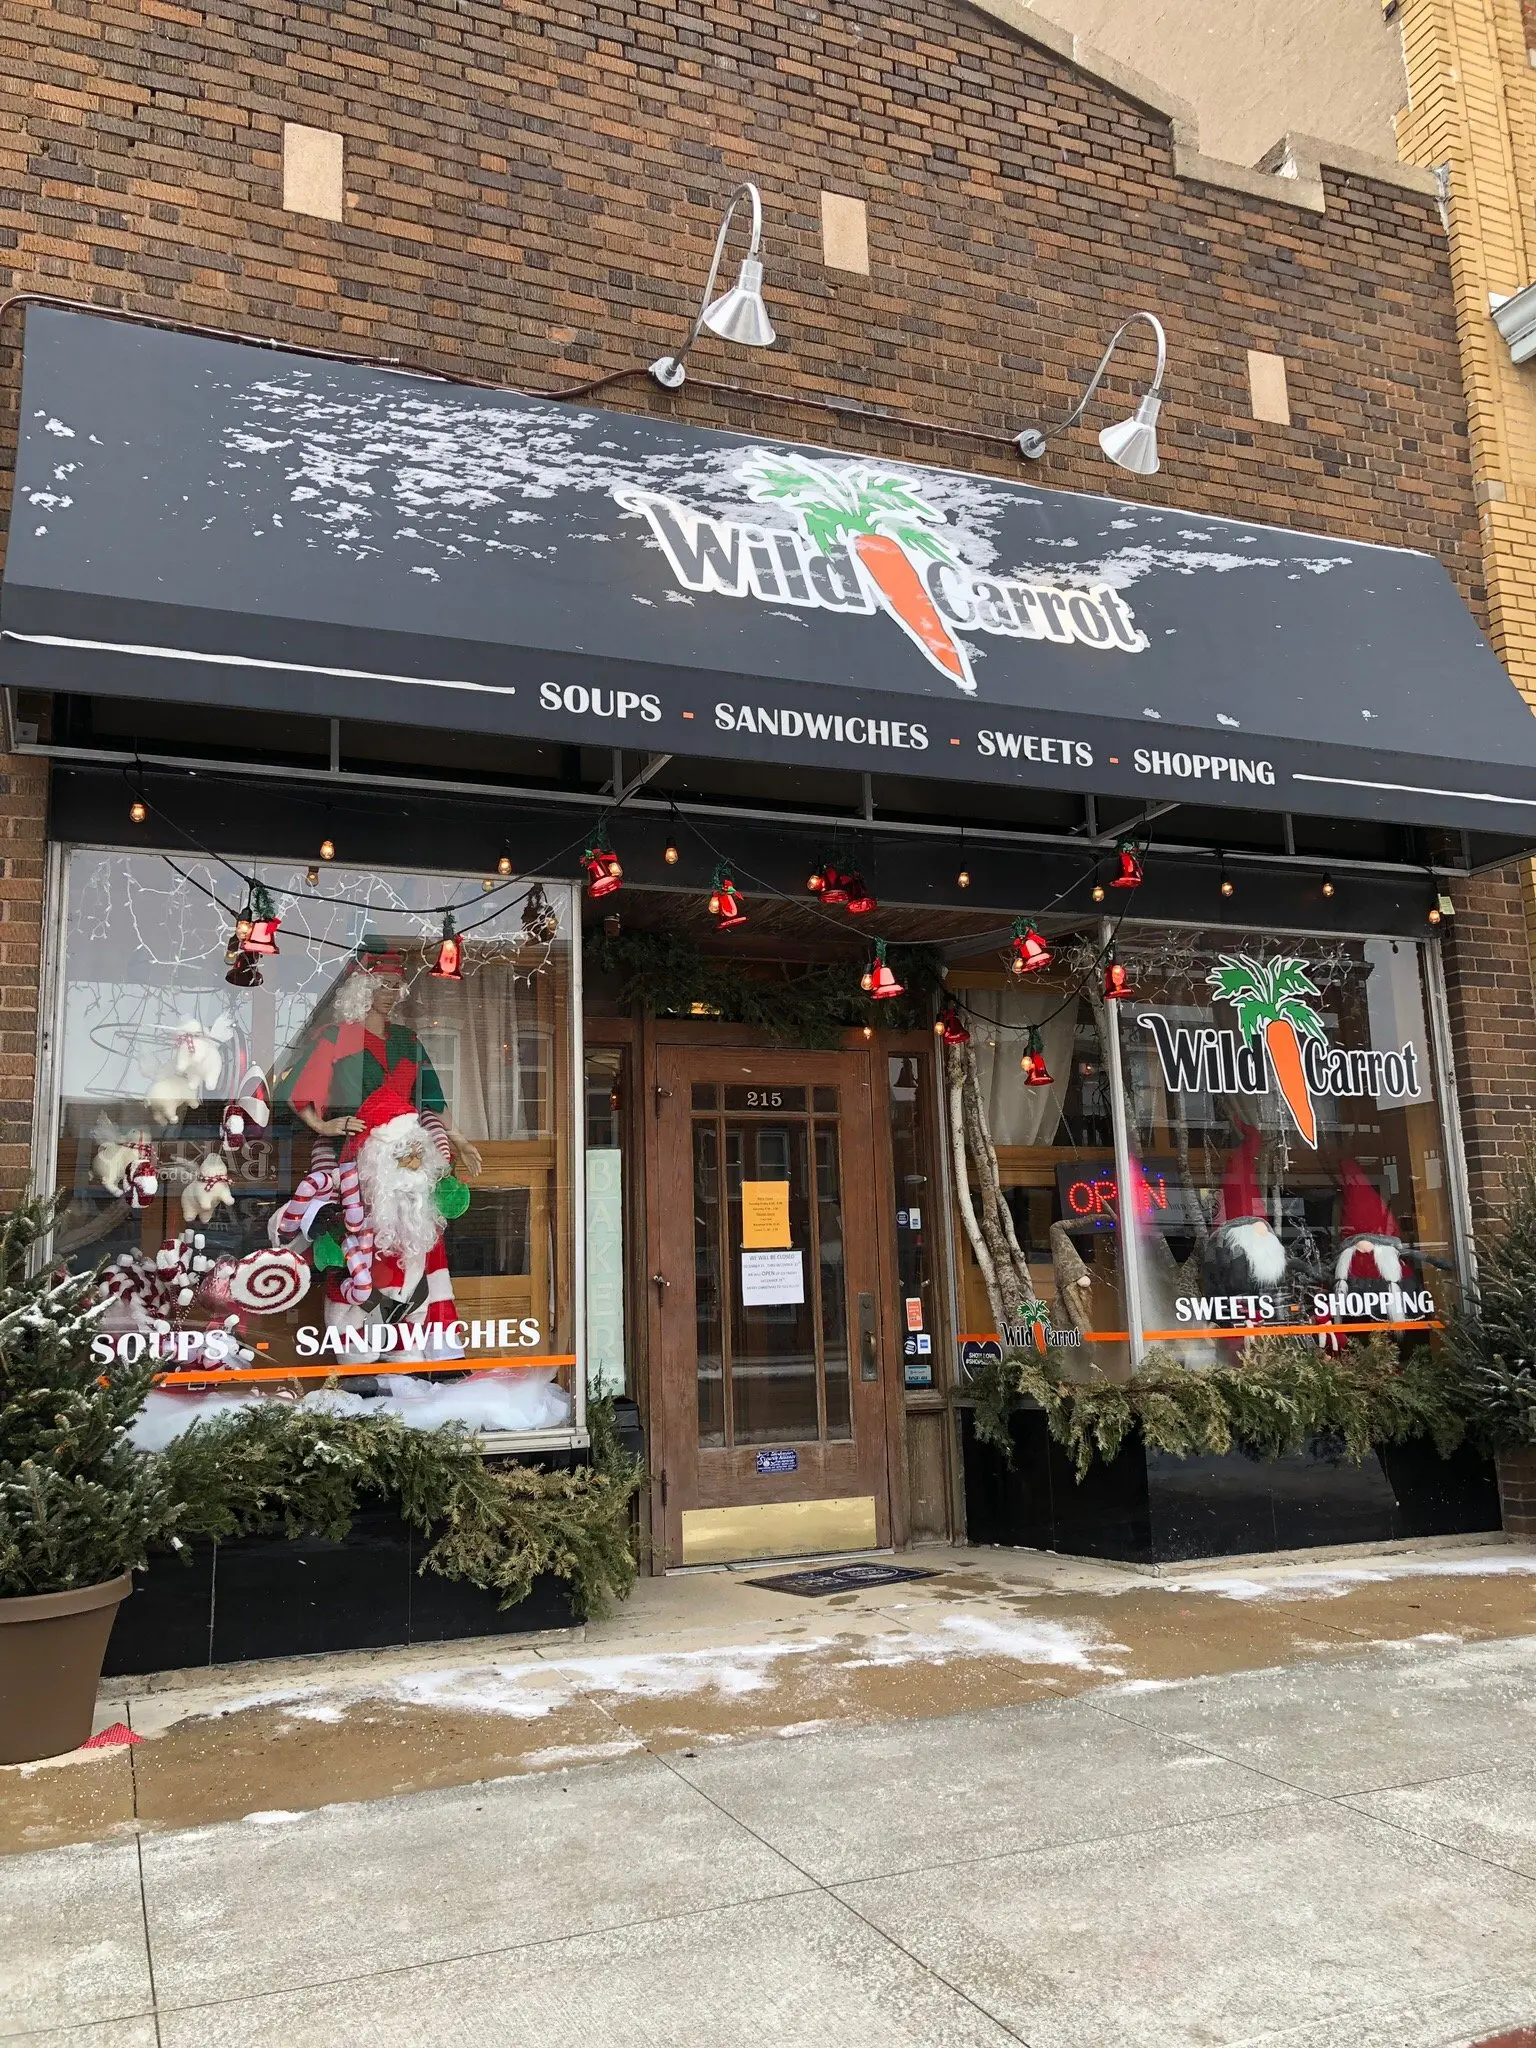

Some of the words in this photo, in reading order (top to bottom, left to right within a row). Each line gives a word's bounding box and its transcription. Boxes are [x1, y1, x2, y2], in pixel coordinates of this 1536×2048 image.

[614, 489, 876, 616] Wild
[923, 560, 1149, 653] Carrot
[539, 681, 662, 723] SOUPS
[714, 702, 930, 750] SANDWICHES
[977, 729, 1094, 767] SWEETS
[1133, 748, 1276, 786] SHOPPING
[1137, 1012, 1269, 1095] Wild
[1302, 1036, 1422, 1097] Carrot
[747, 1091, 782, 1107] 215
[1069, 1178, 1167, 1214] OPN
[1175, 1294, 1275, 1322] SWEETS
[1314, 1290, 1435, 1317] SHOPPING
[89, 1329, 230, 1365] SOUPS
[295, 1317, 541, 1356] SANDWICHES
[1000, 1321, 1033, 1347] Wild
[1044, 1326, 1081, 1347] Carrot
